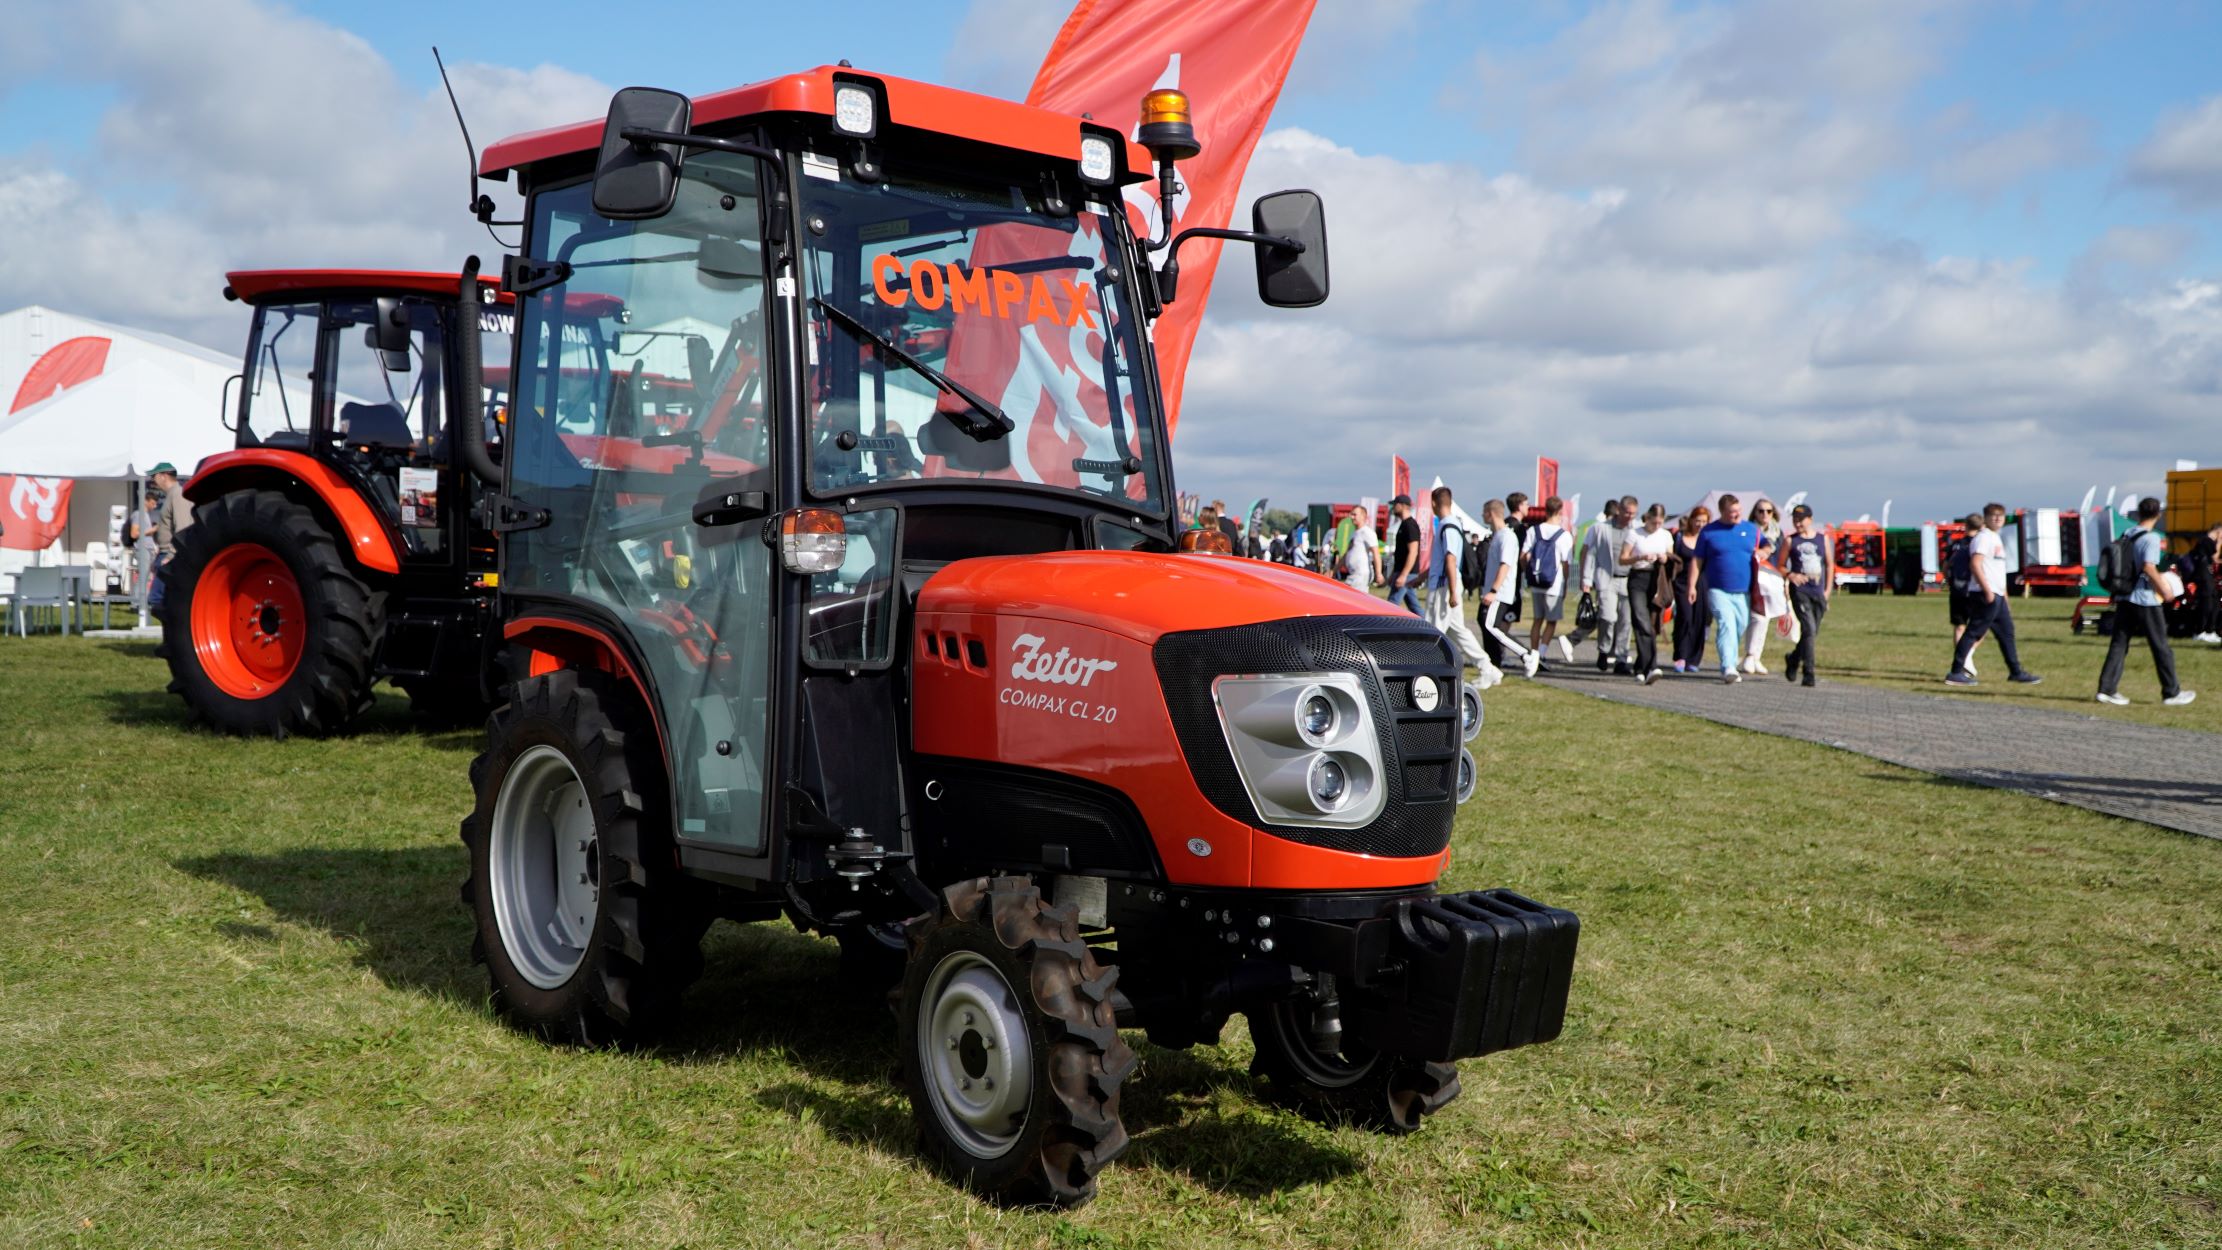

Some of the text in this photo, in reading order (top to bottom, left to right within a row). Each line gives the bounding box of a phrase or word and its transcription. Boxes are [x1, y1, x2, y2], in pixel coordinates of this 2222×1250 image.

[872, 254, 1098, 329] COMPAX
[478, 312, 515, 335] NOW
[1011, 633, 1117, 686] Zetor
[1000, 688, 1117, 724] COMPAX CL 20
[1415, 689, 1438, 699] Zetor
